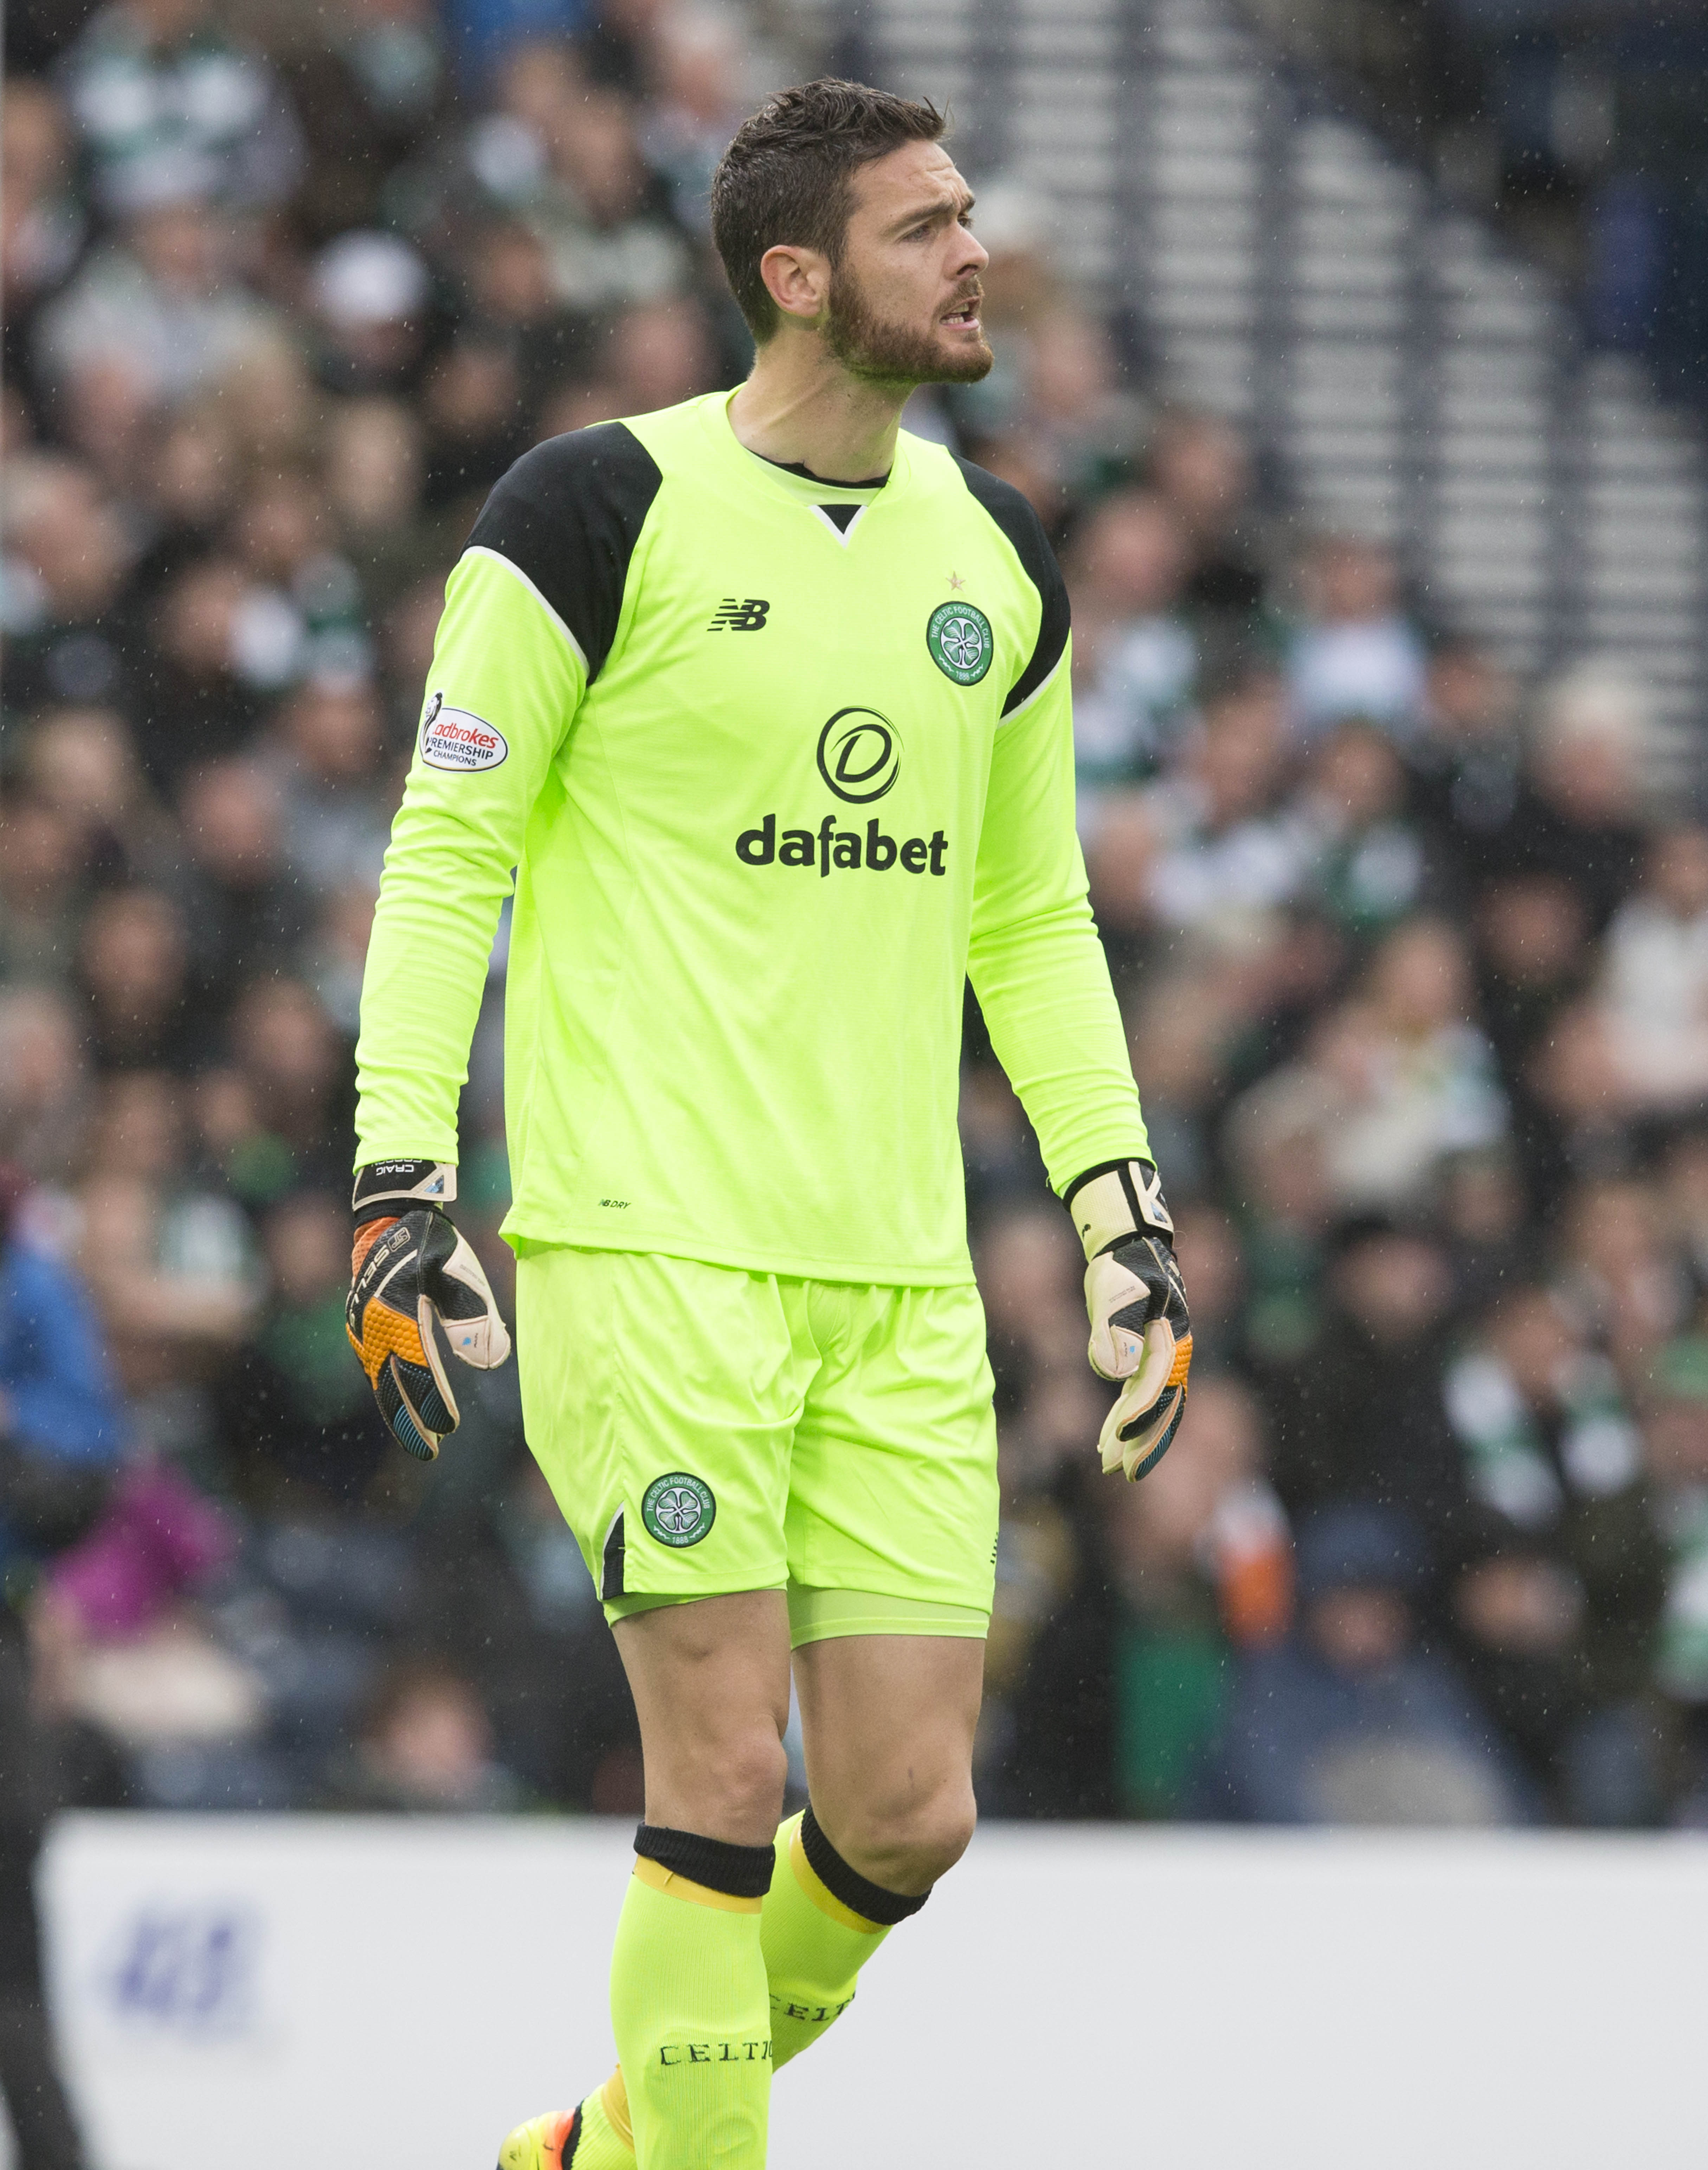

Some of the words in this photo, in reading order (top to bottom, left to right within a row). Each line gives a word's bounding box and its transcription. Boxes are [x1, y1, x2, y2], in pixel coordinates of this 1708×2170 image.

[935, 607, 953, 624] CELTIC
[953, 606, 984, 629] FOOTBALL
[931, 624, 940, 638] THE
[956, 671, 970, 681] 1888
[432, 722, 499, 749] adbrokes
[433, 749, 477, 766] CHAMPIONS
[735, 813, 948, 878] dafabet
[376, 1164, 414, 1176] CRAIG
[646, 1498, 655, 1512] THE
[651, 1480, 669, 1498] CELTIC
[669, 1477, 702, 1493] FOOTBALL
[700, 1491, 710, 1509] CLUB
[672, 1535, 689, 1544] 1888
